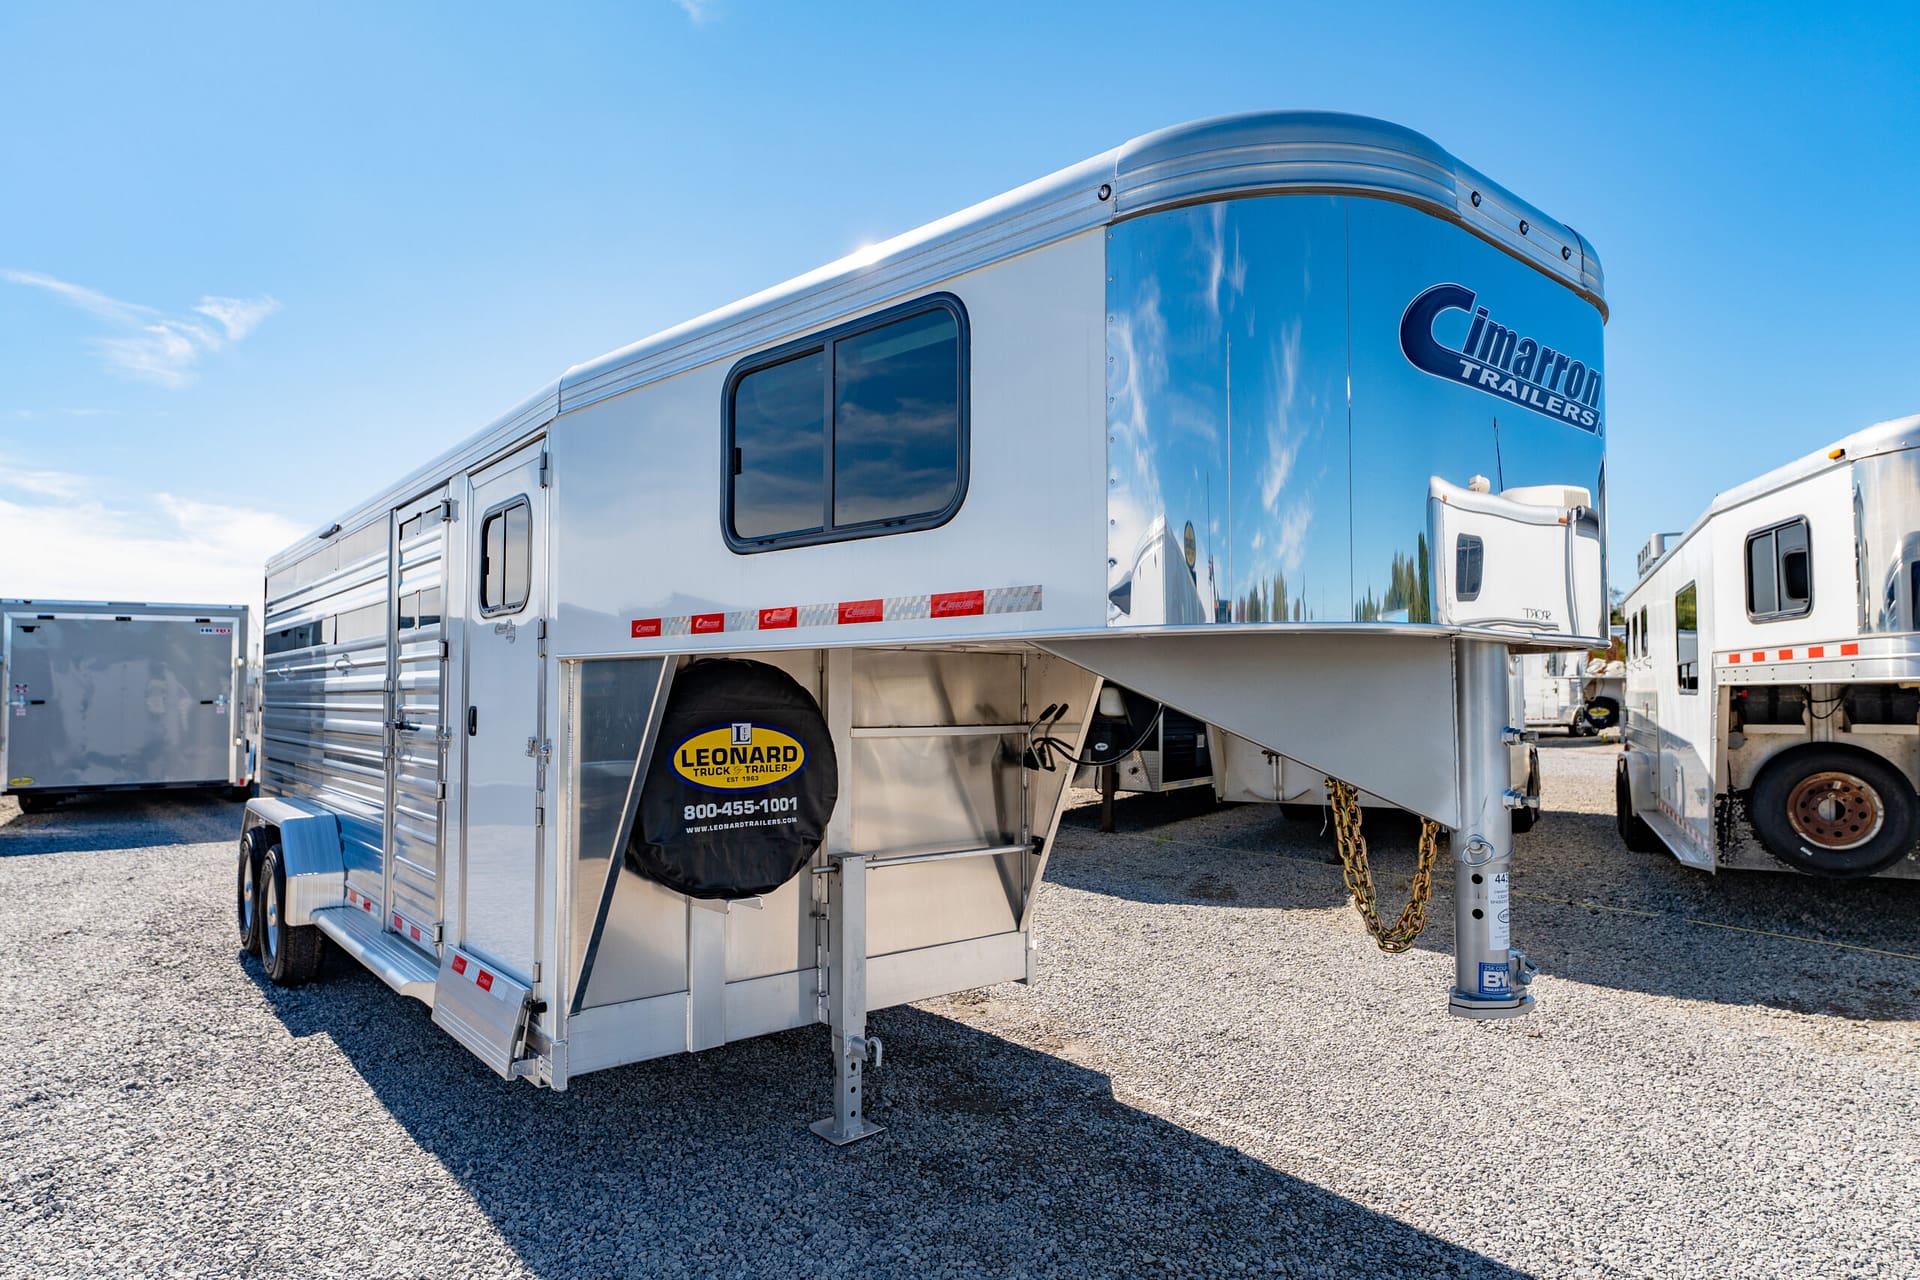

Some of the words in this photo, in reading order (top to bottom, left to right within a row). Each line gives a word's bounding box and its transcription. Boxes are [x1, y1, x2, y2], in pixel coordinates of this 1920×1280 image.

[1399, 282, 1602, 409] Cimarron
[1459, 358, 1596, 427] TRAILERS
[681, 745, 798, 768] LEONARD
[693, 766, 731, 777] TRUCK
[745, 763, 789, 774] TRAILER
[684, 796, 798, 821] 800-455-1001
[685, 816, 798, 834] WWW.LEONARDTRAILERS.COM
